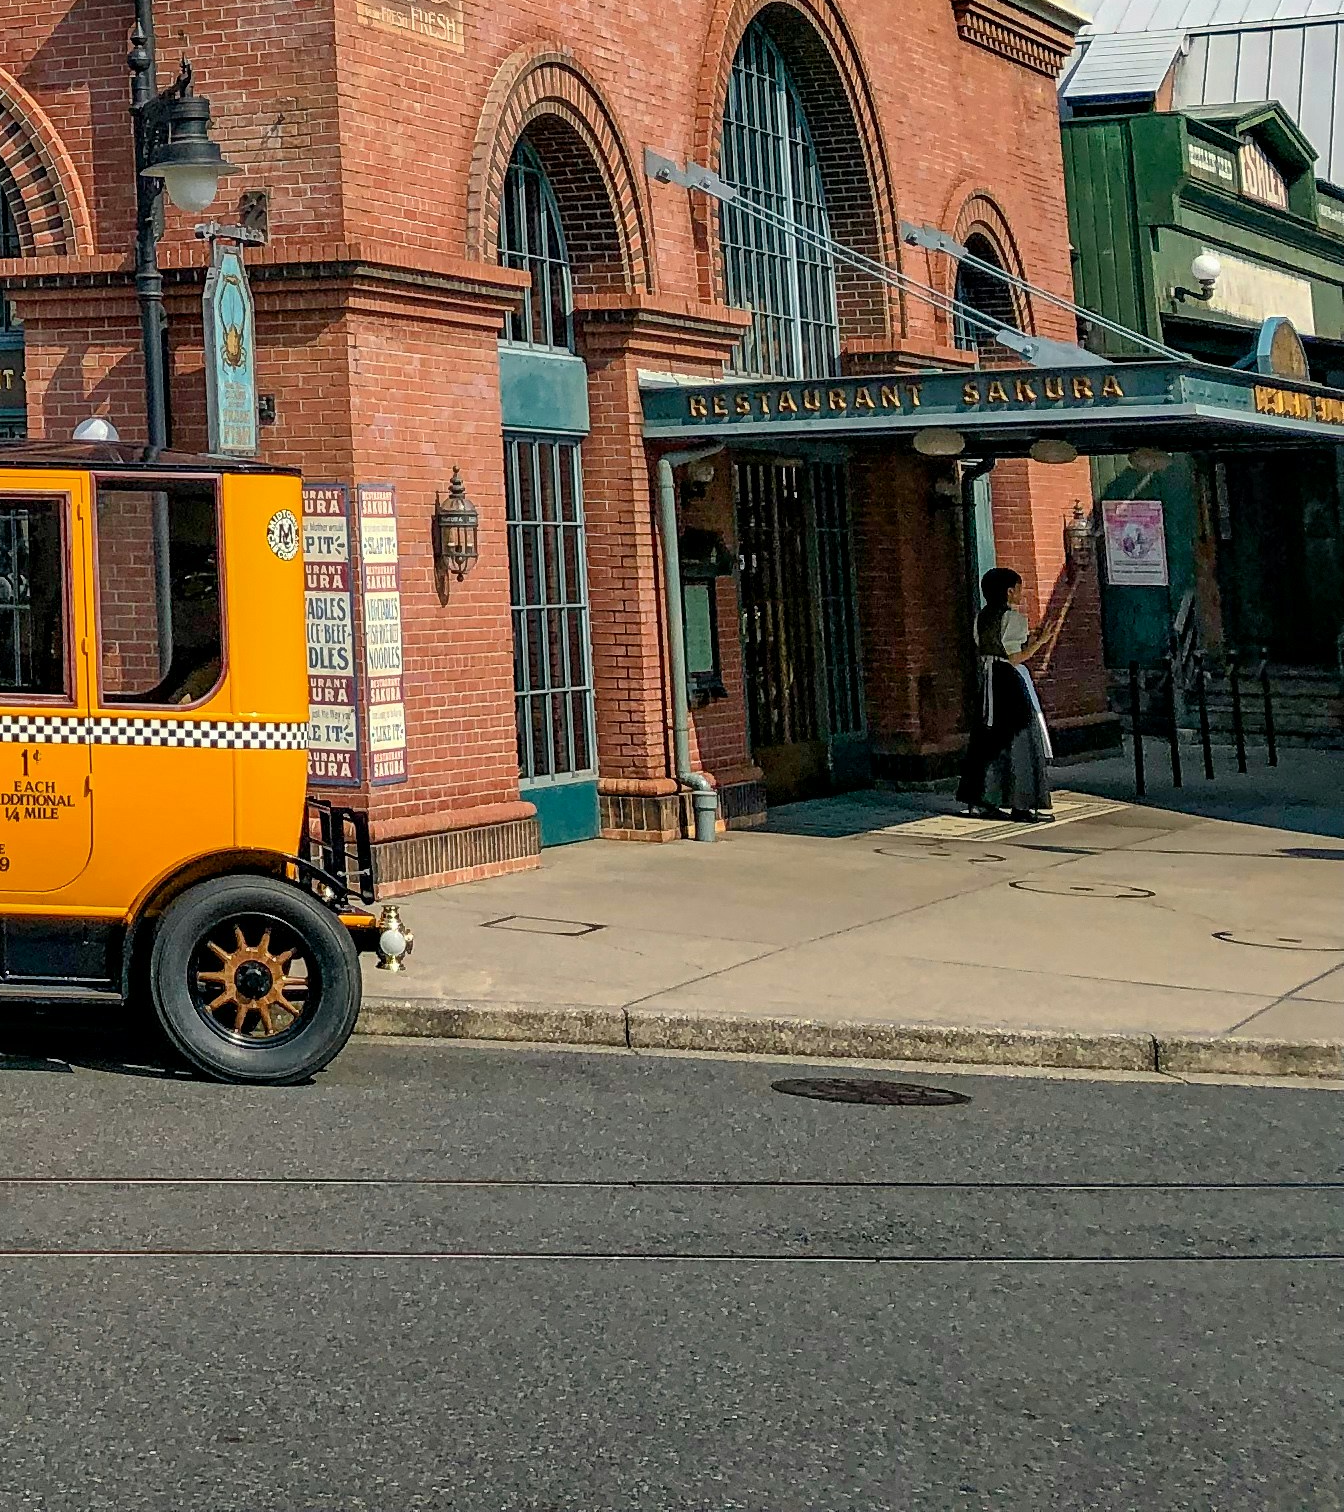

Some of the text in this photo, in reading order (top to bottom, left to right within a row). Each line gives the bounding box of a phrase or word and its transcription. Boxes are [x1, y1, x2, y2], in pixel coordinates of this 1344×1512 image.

[689, 374, 1125, 418] RESTAURANT SAKURA
[363, 499, 393, 515] SAKURA
[367, 575, 396, 589] SAKURA
[369, 646, 400, 670] NOODLES
[371, 687, 401, 703] SAKURA
[374, 760, 404, 778] SAKURA
[13, 780, 56, 794] EACH
[23, 806, 60, 820] MILE
